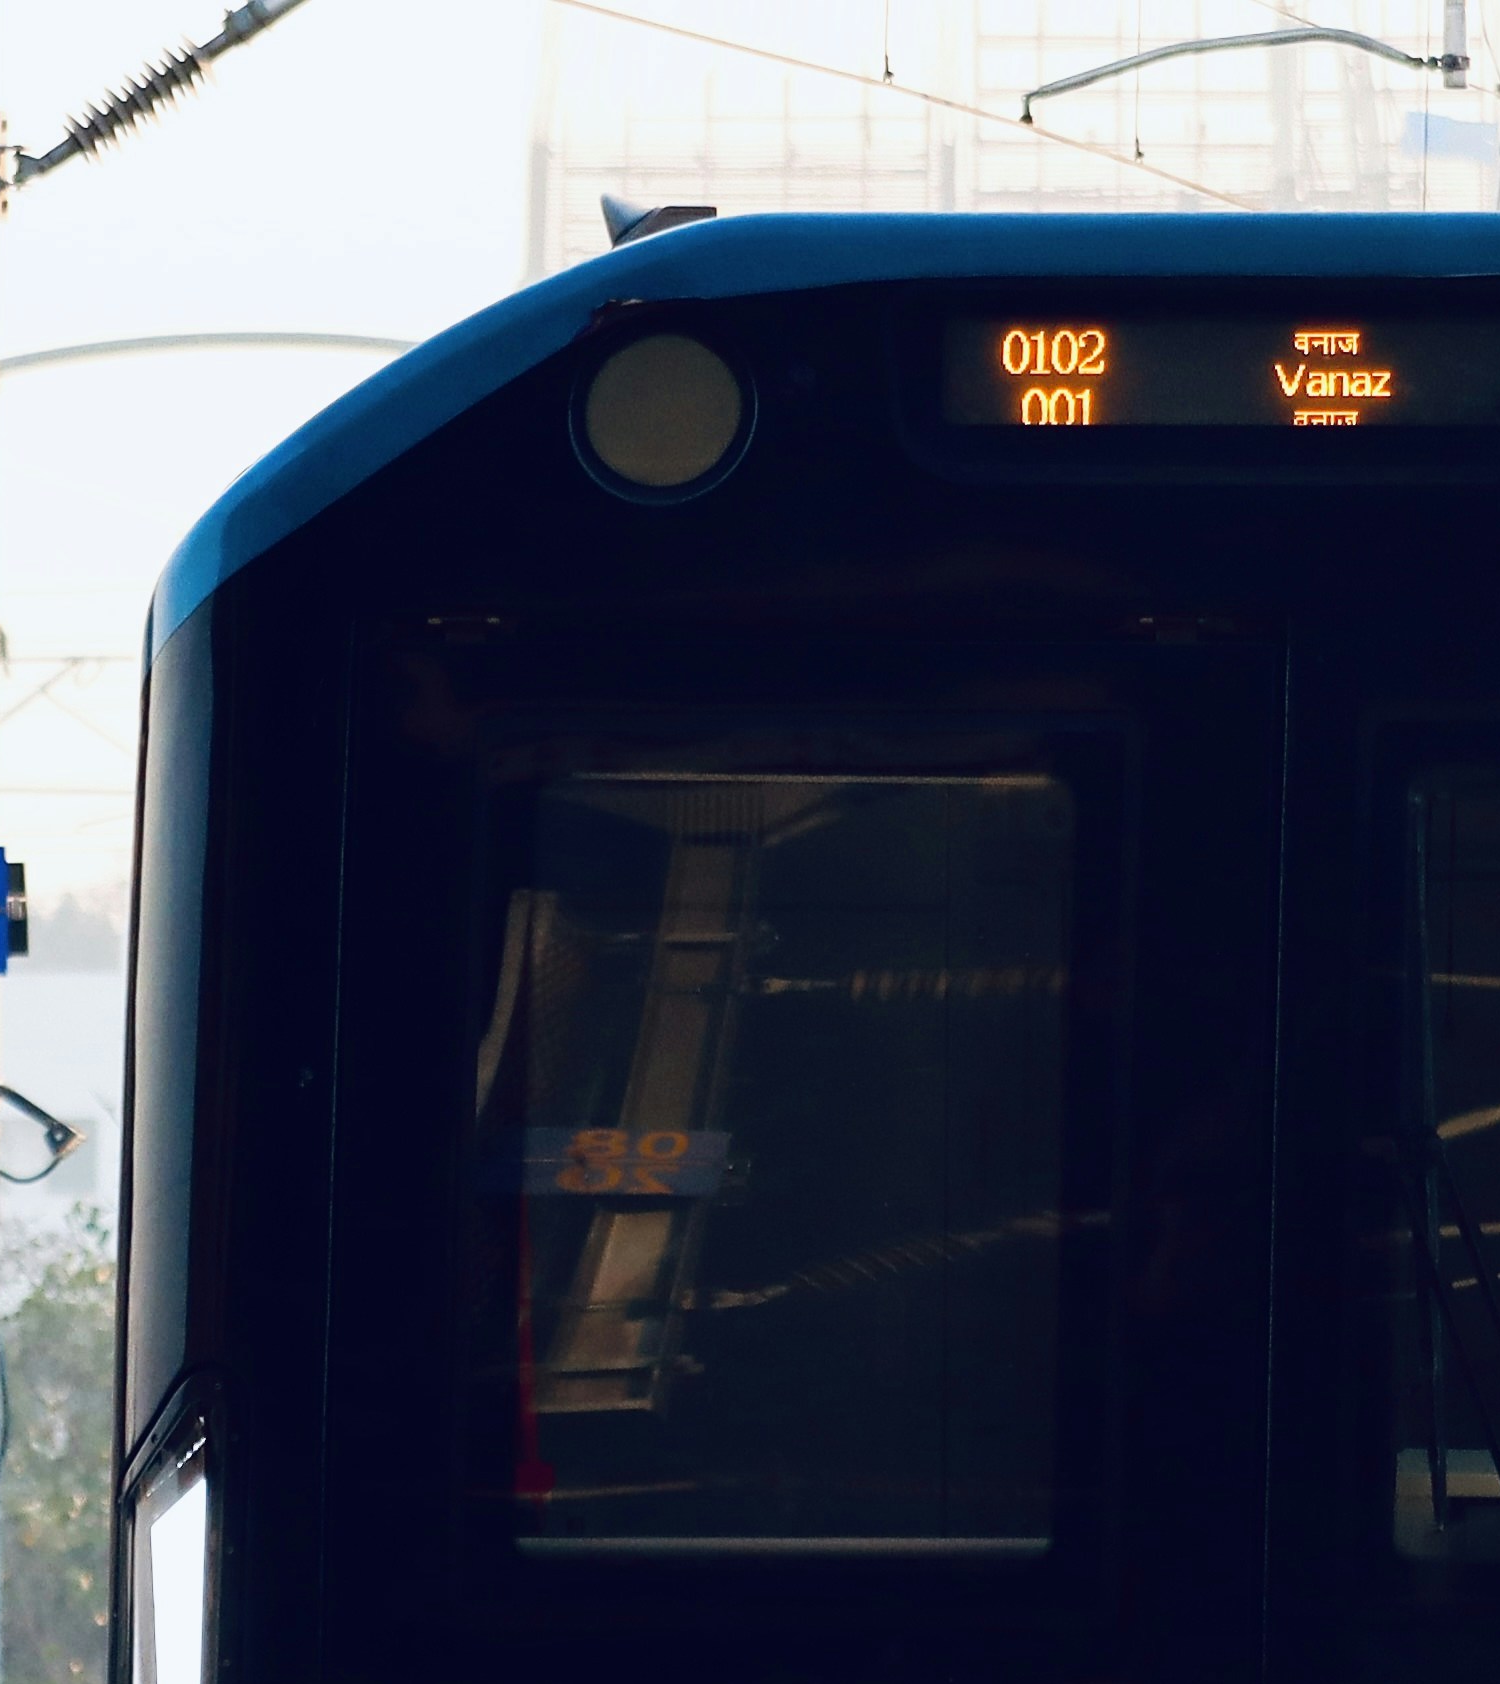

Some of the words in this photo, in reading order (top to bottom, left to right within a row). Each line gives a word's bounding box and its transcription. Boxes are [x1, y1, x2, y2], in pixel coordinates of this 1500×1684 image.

[1002, 331, 1106, 375] 0102
[1294, 332, 1360, 356] वनाज
[1275, 364, 1391, 398] Vanaz
[1021, 389, 1092, 426] 001
